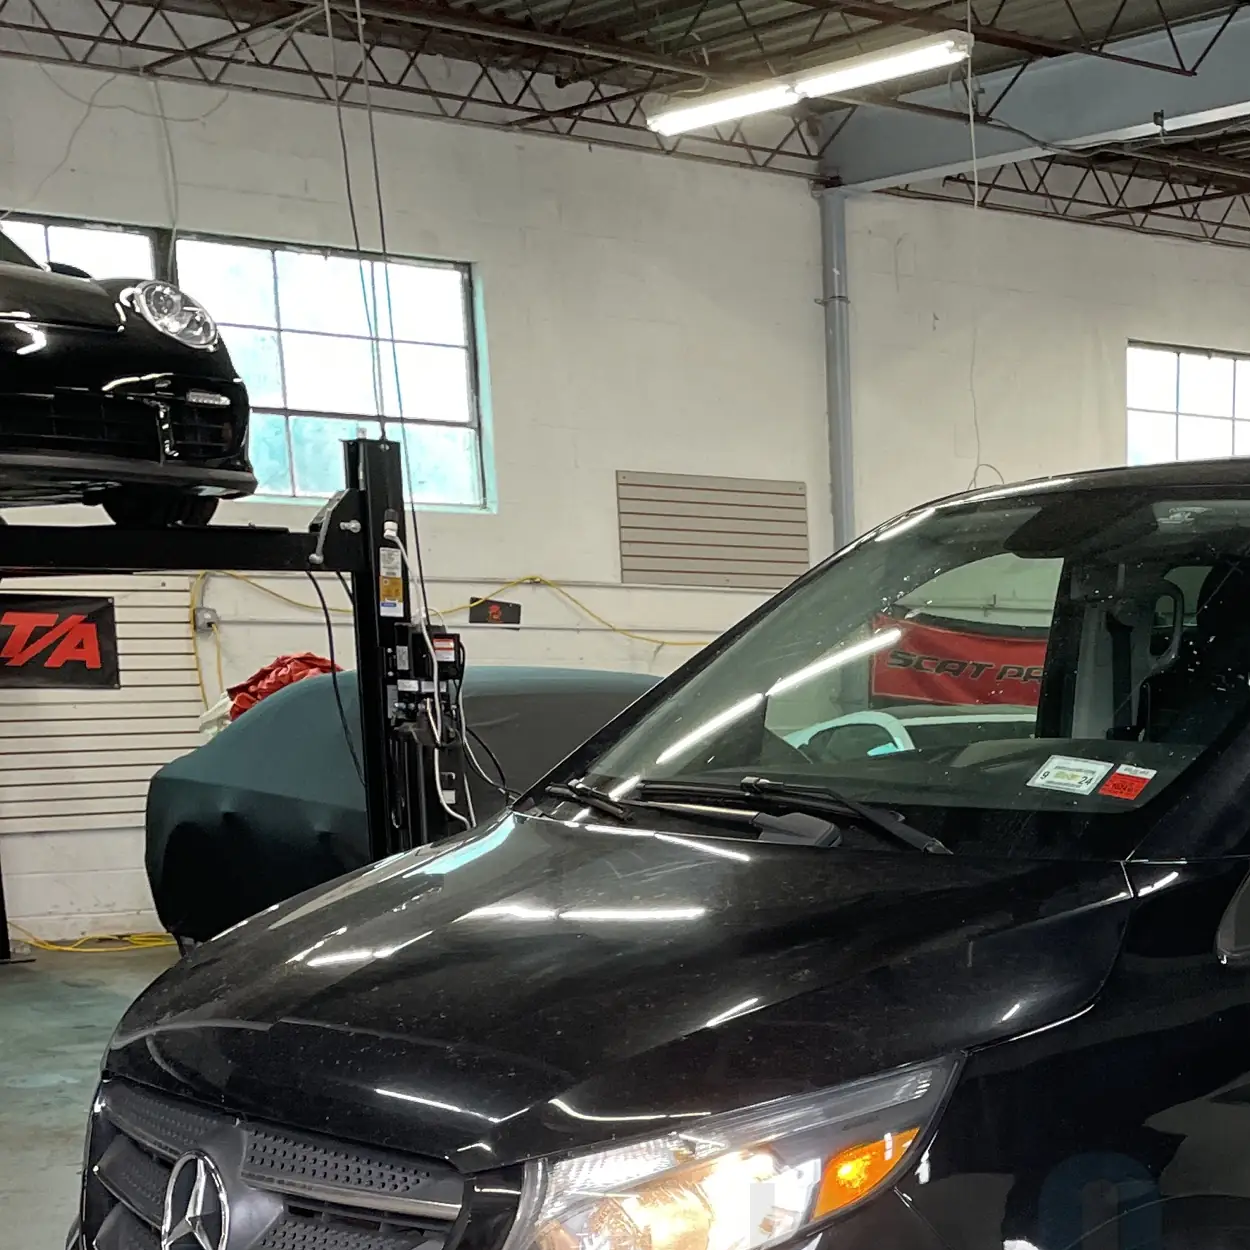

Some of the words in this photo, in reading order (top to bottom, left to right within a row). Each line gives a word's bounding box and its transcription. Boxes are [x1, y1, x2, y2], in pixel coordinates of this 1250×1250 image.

[0, 611, 102, 669] T/A
[887, 650, 994, 681] SCAT
[1078, 775, 1094, 786] 24
